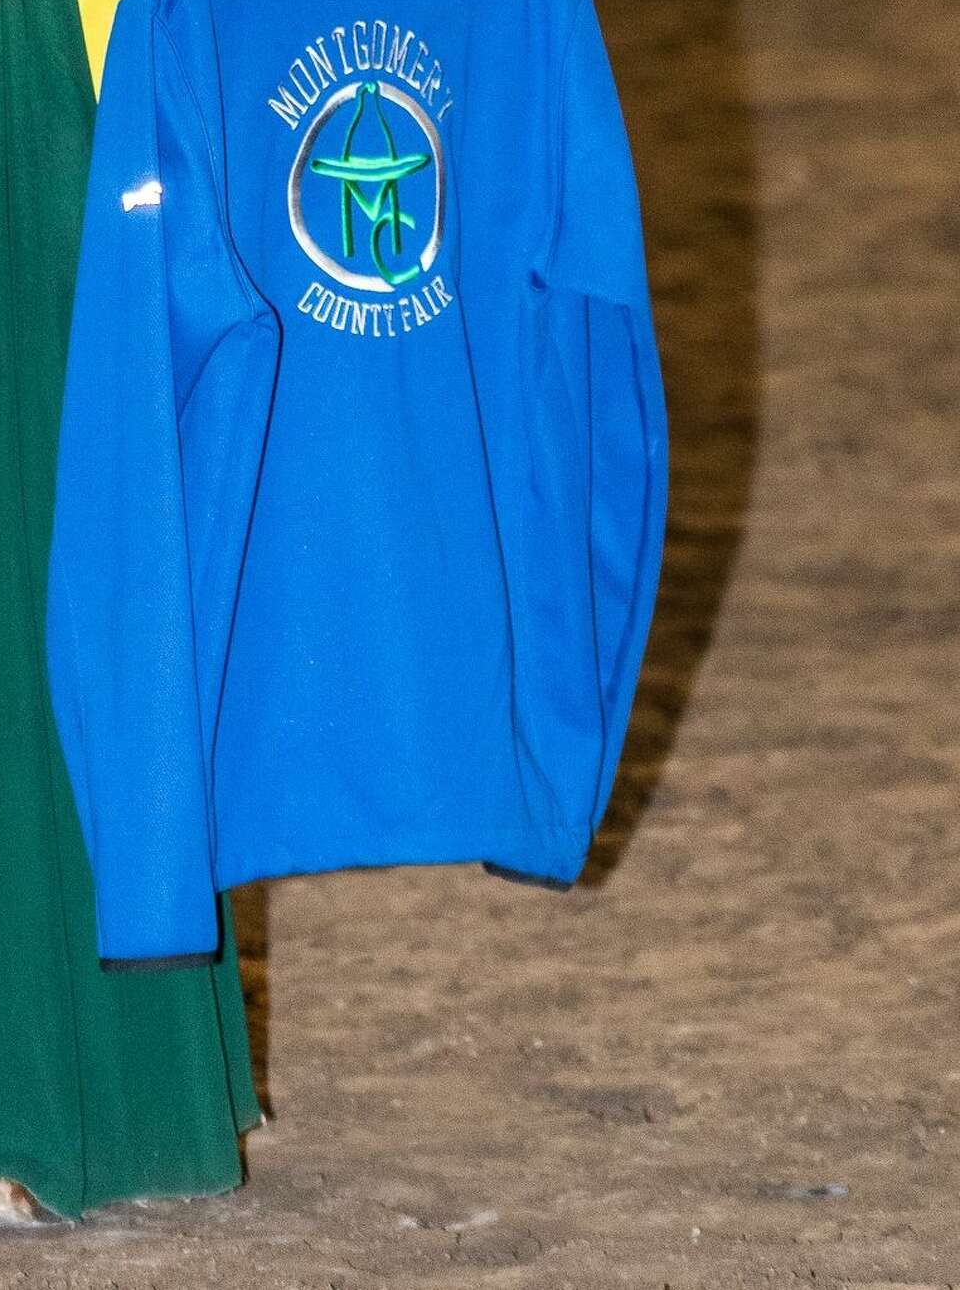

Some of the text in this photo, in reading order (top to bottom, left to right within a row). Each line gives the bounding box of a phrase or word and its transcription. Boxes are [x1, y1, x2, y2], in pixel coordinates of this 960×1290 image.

[267, 19, 454, 130] MONTGOMERY
[296, 275, 455, 338] COUNTY FAIR
